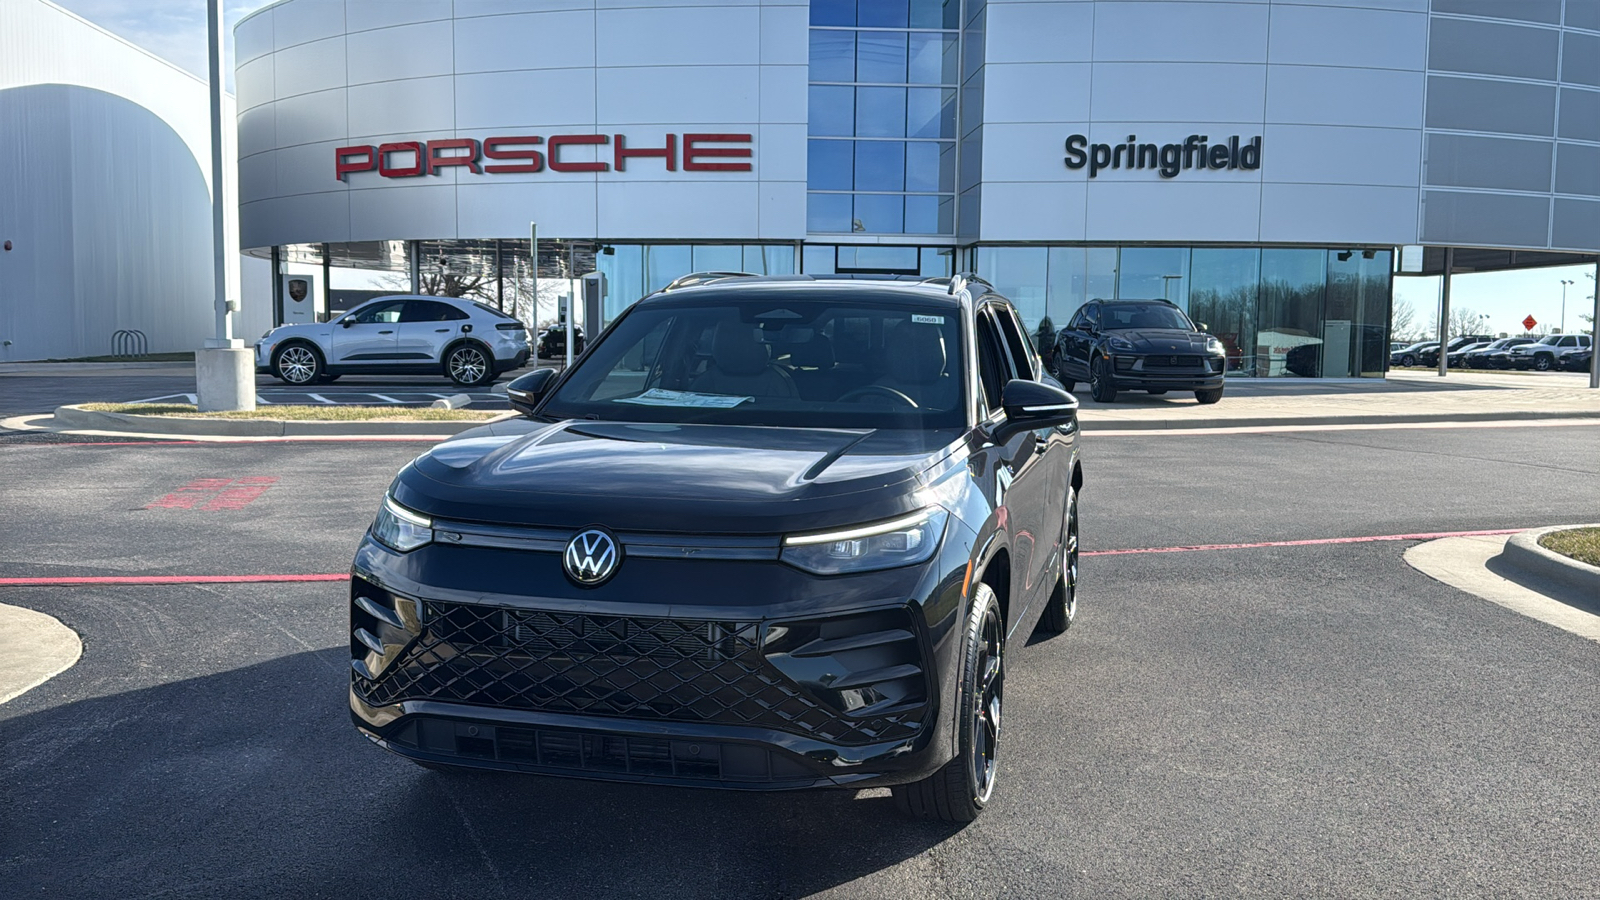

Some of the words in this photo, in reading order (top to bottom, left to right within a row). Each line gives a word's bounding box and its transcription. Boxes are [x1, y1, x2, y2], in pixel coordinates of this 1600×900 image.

[335, 133, 753, 182] PORSCHE
[1064, 134, 1262, 178] Springfield
[566, 530, 616, 581] VW
